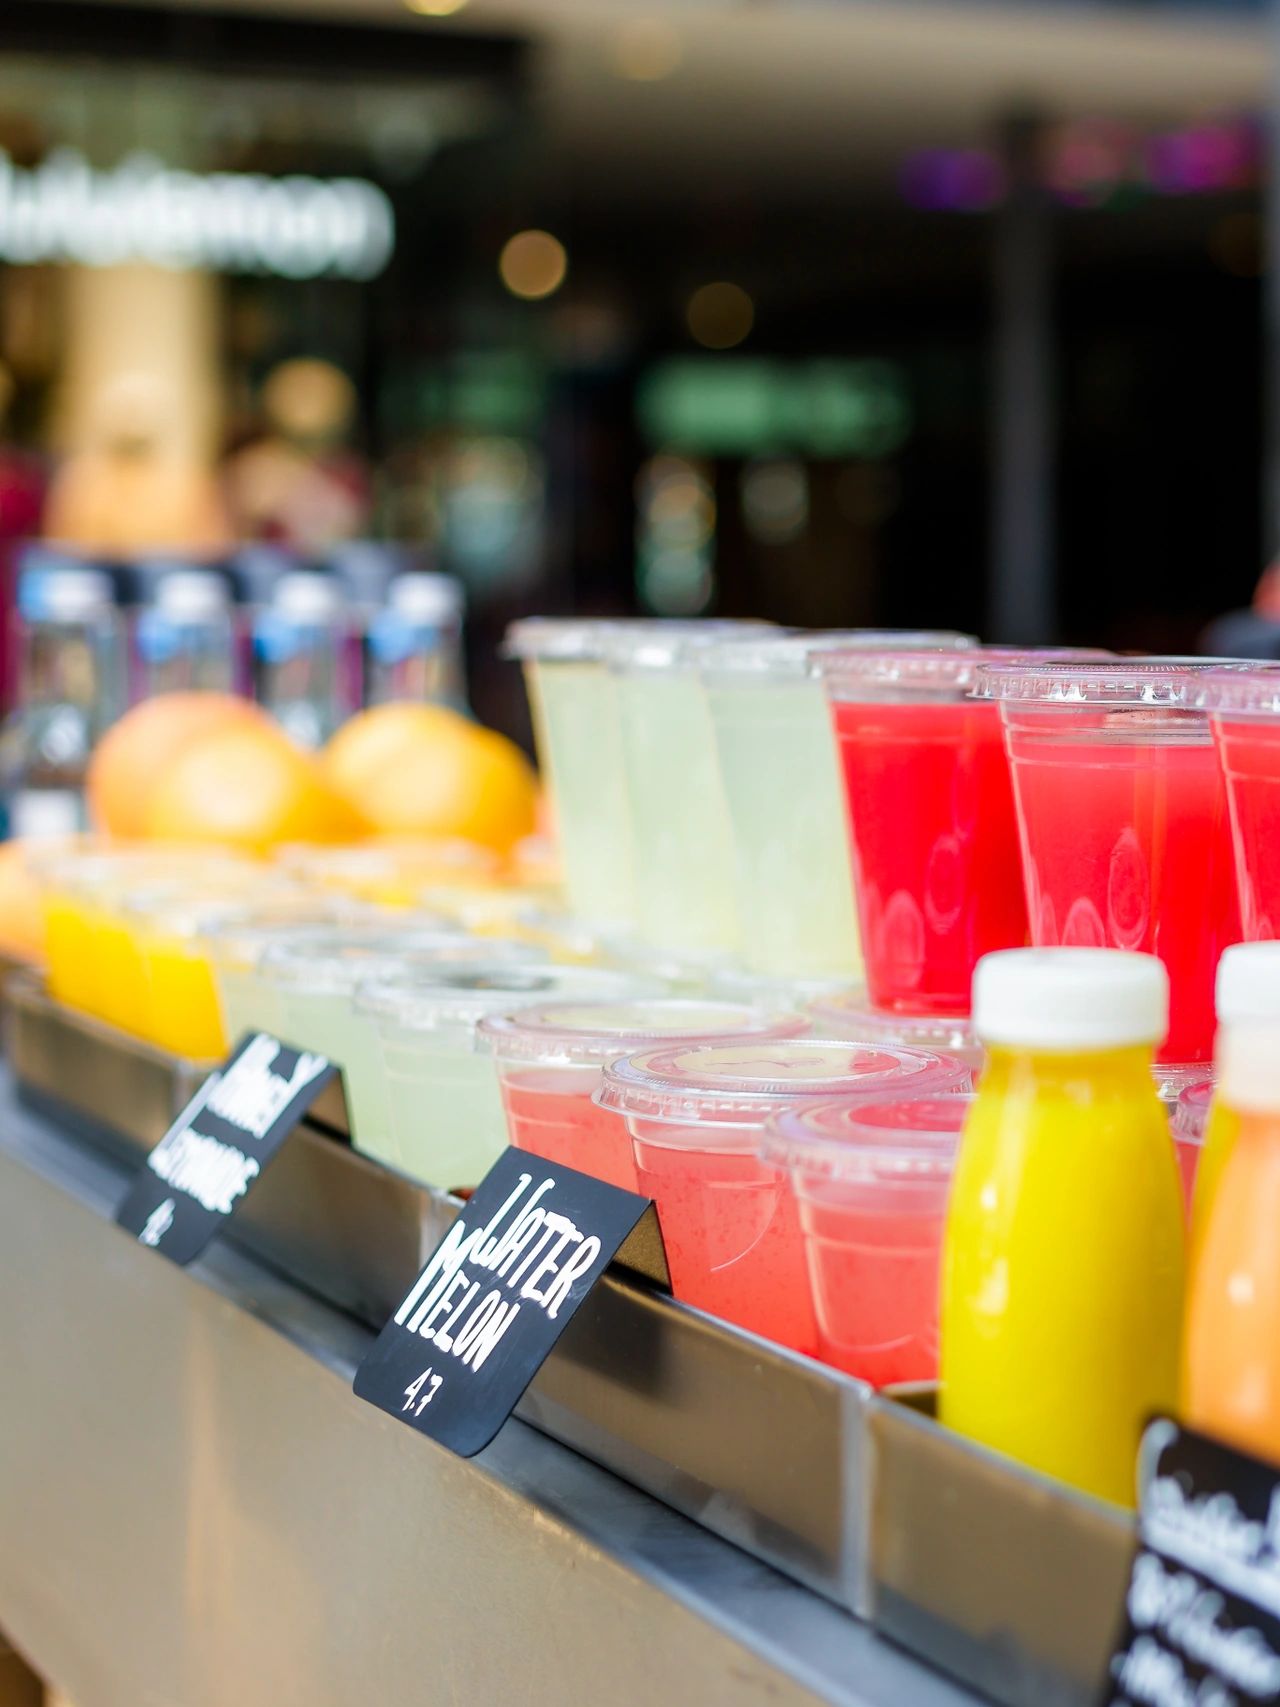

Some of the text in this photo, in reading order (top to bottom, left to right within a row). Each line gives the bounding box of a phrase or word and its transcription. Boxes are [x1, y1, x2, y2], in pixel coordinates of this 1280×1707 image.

[393, 1219, 521, 1373] MELON
[468, 1173, 602, 1320] WATER
[401, 1366, 444, 1417] 4.7
